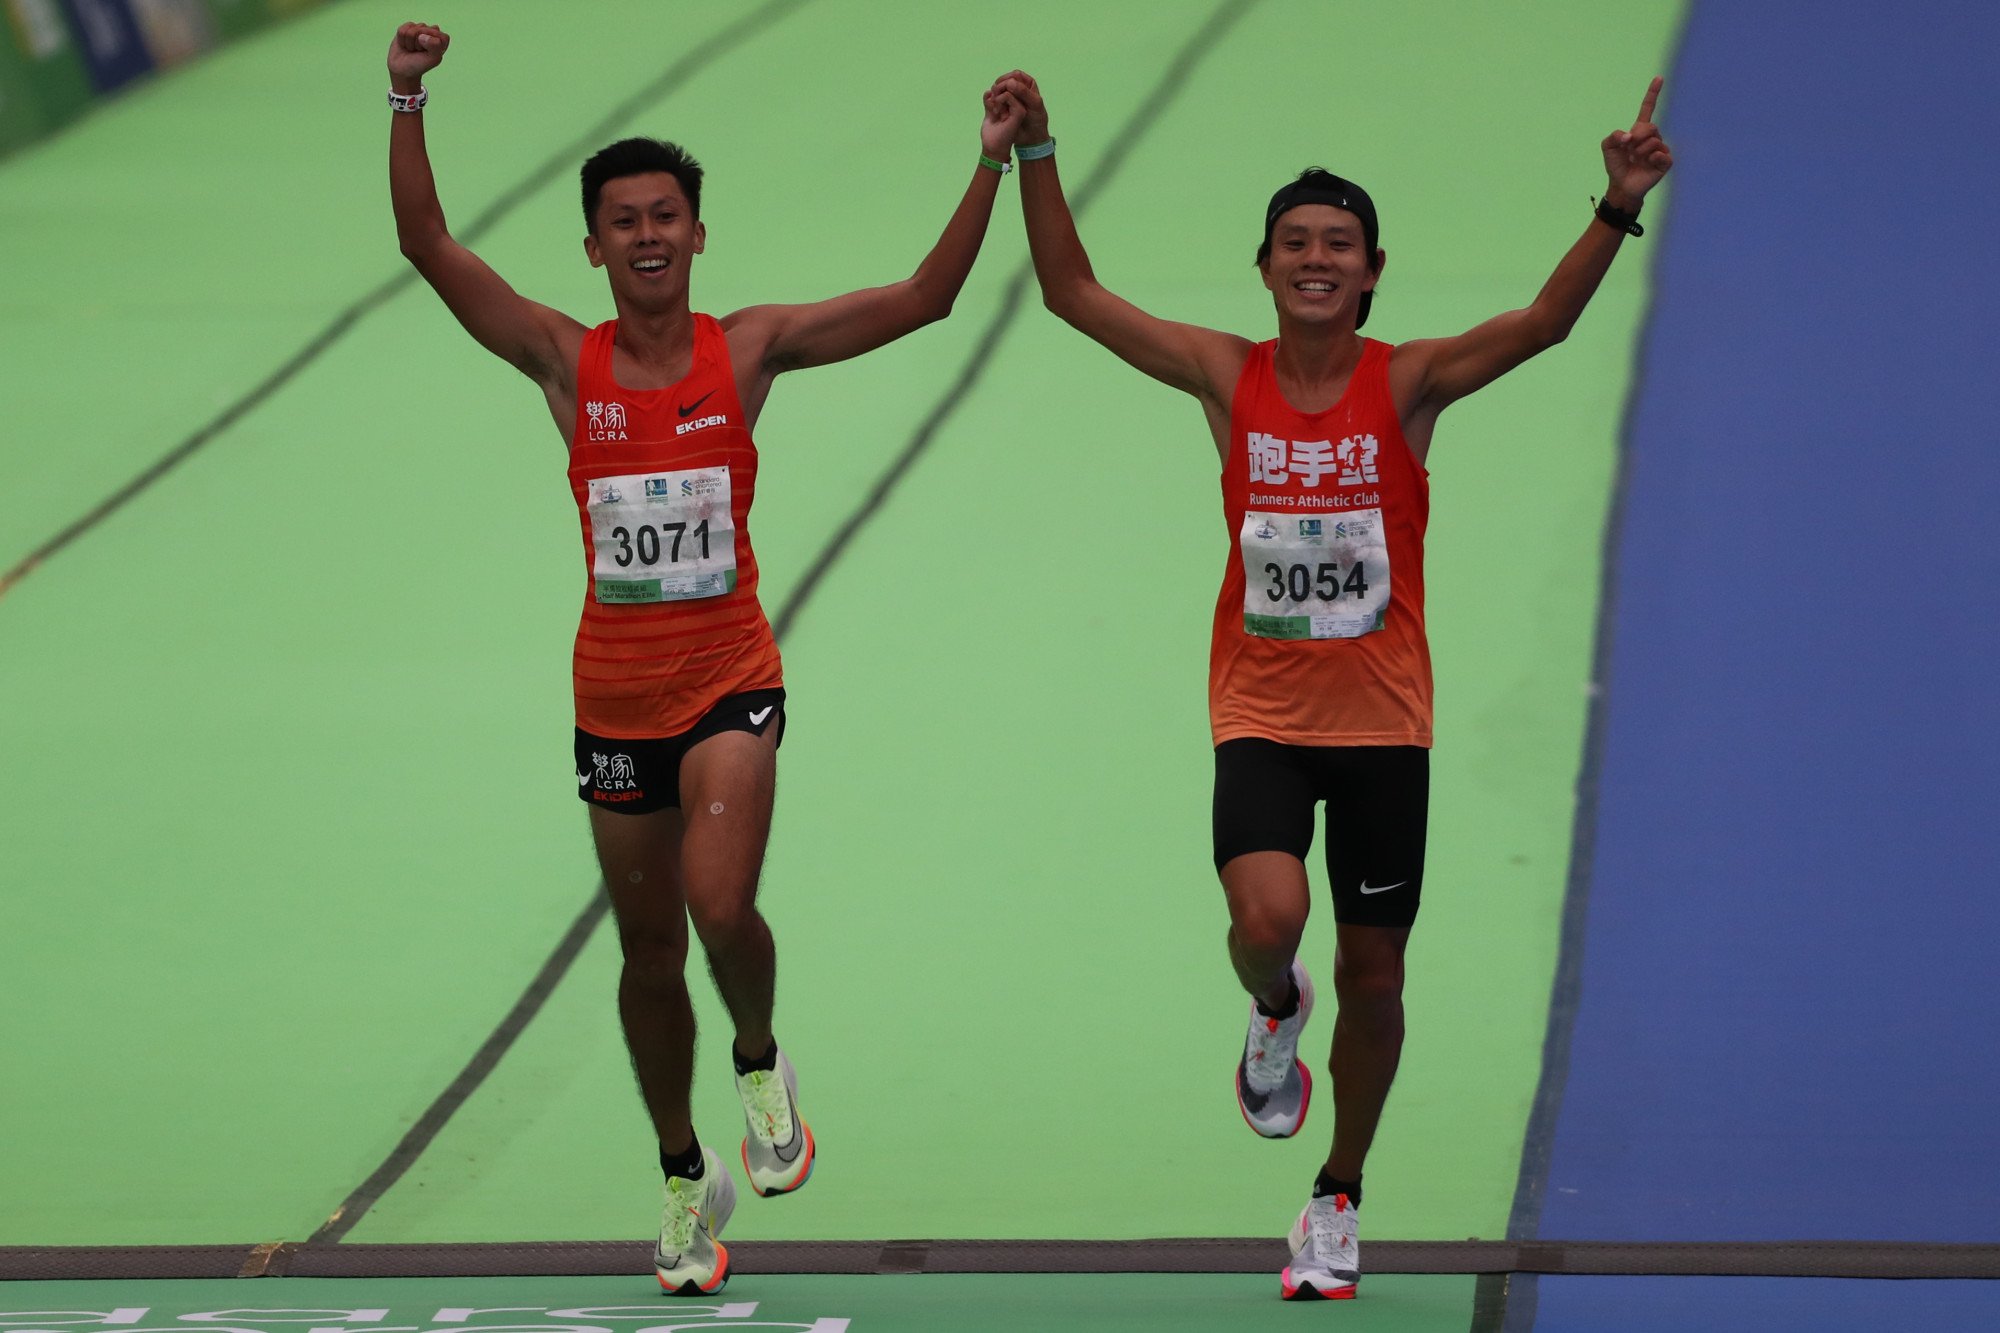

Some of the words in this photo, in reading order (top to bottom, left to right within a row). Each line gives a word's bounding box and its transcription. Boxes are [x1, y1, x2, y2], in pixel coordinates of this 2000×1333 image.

[589, 431, 628, 441] LCRA
[1249, 493, 1294, 505] Runners
[1297, 494, 1350, 507] Athletic
[1353, 491, 1380, 505] Club
[611, 519, 710, 567] 3071
[1265, 561, 1369, 603] 3054
[596, 779, 636, 789] LCRA
